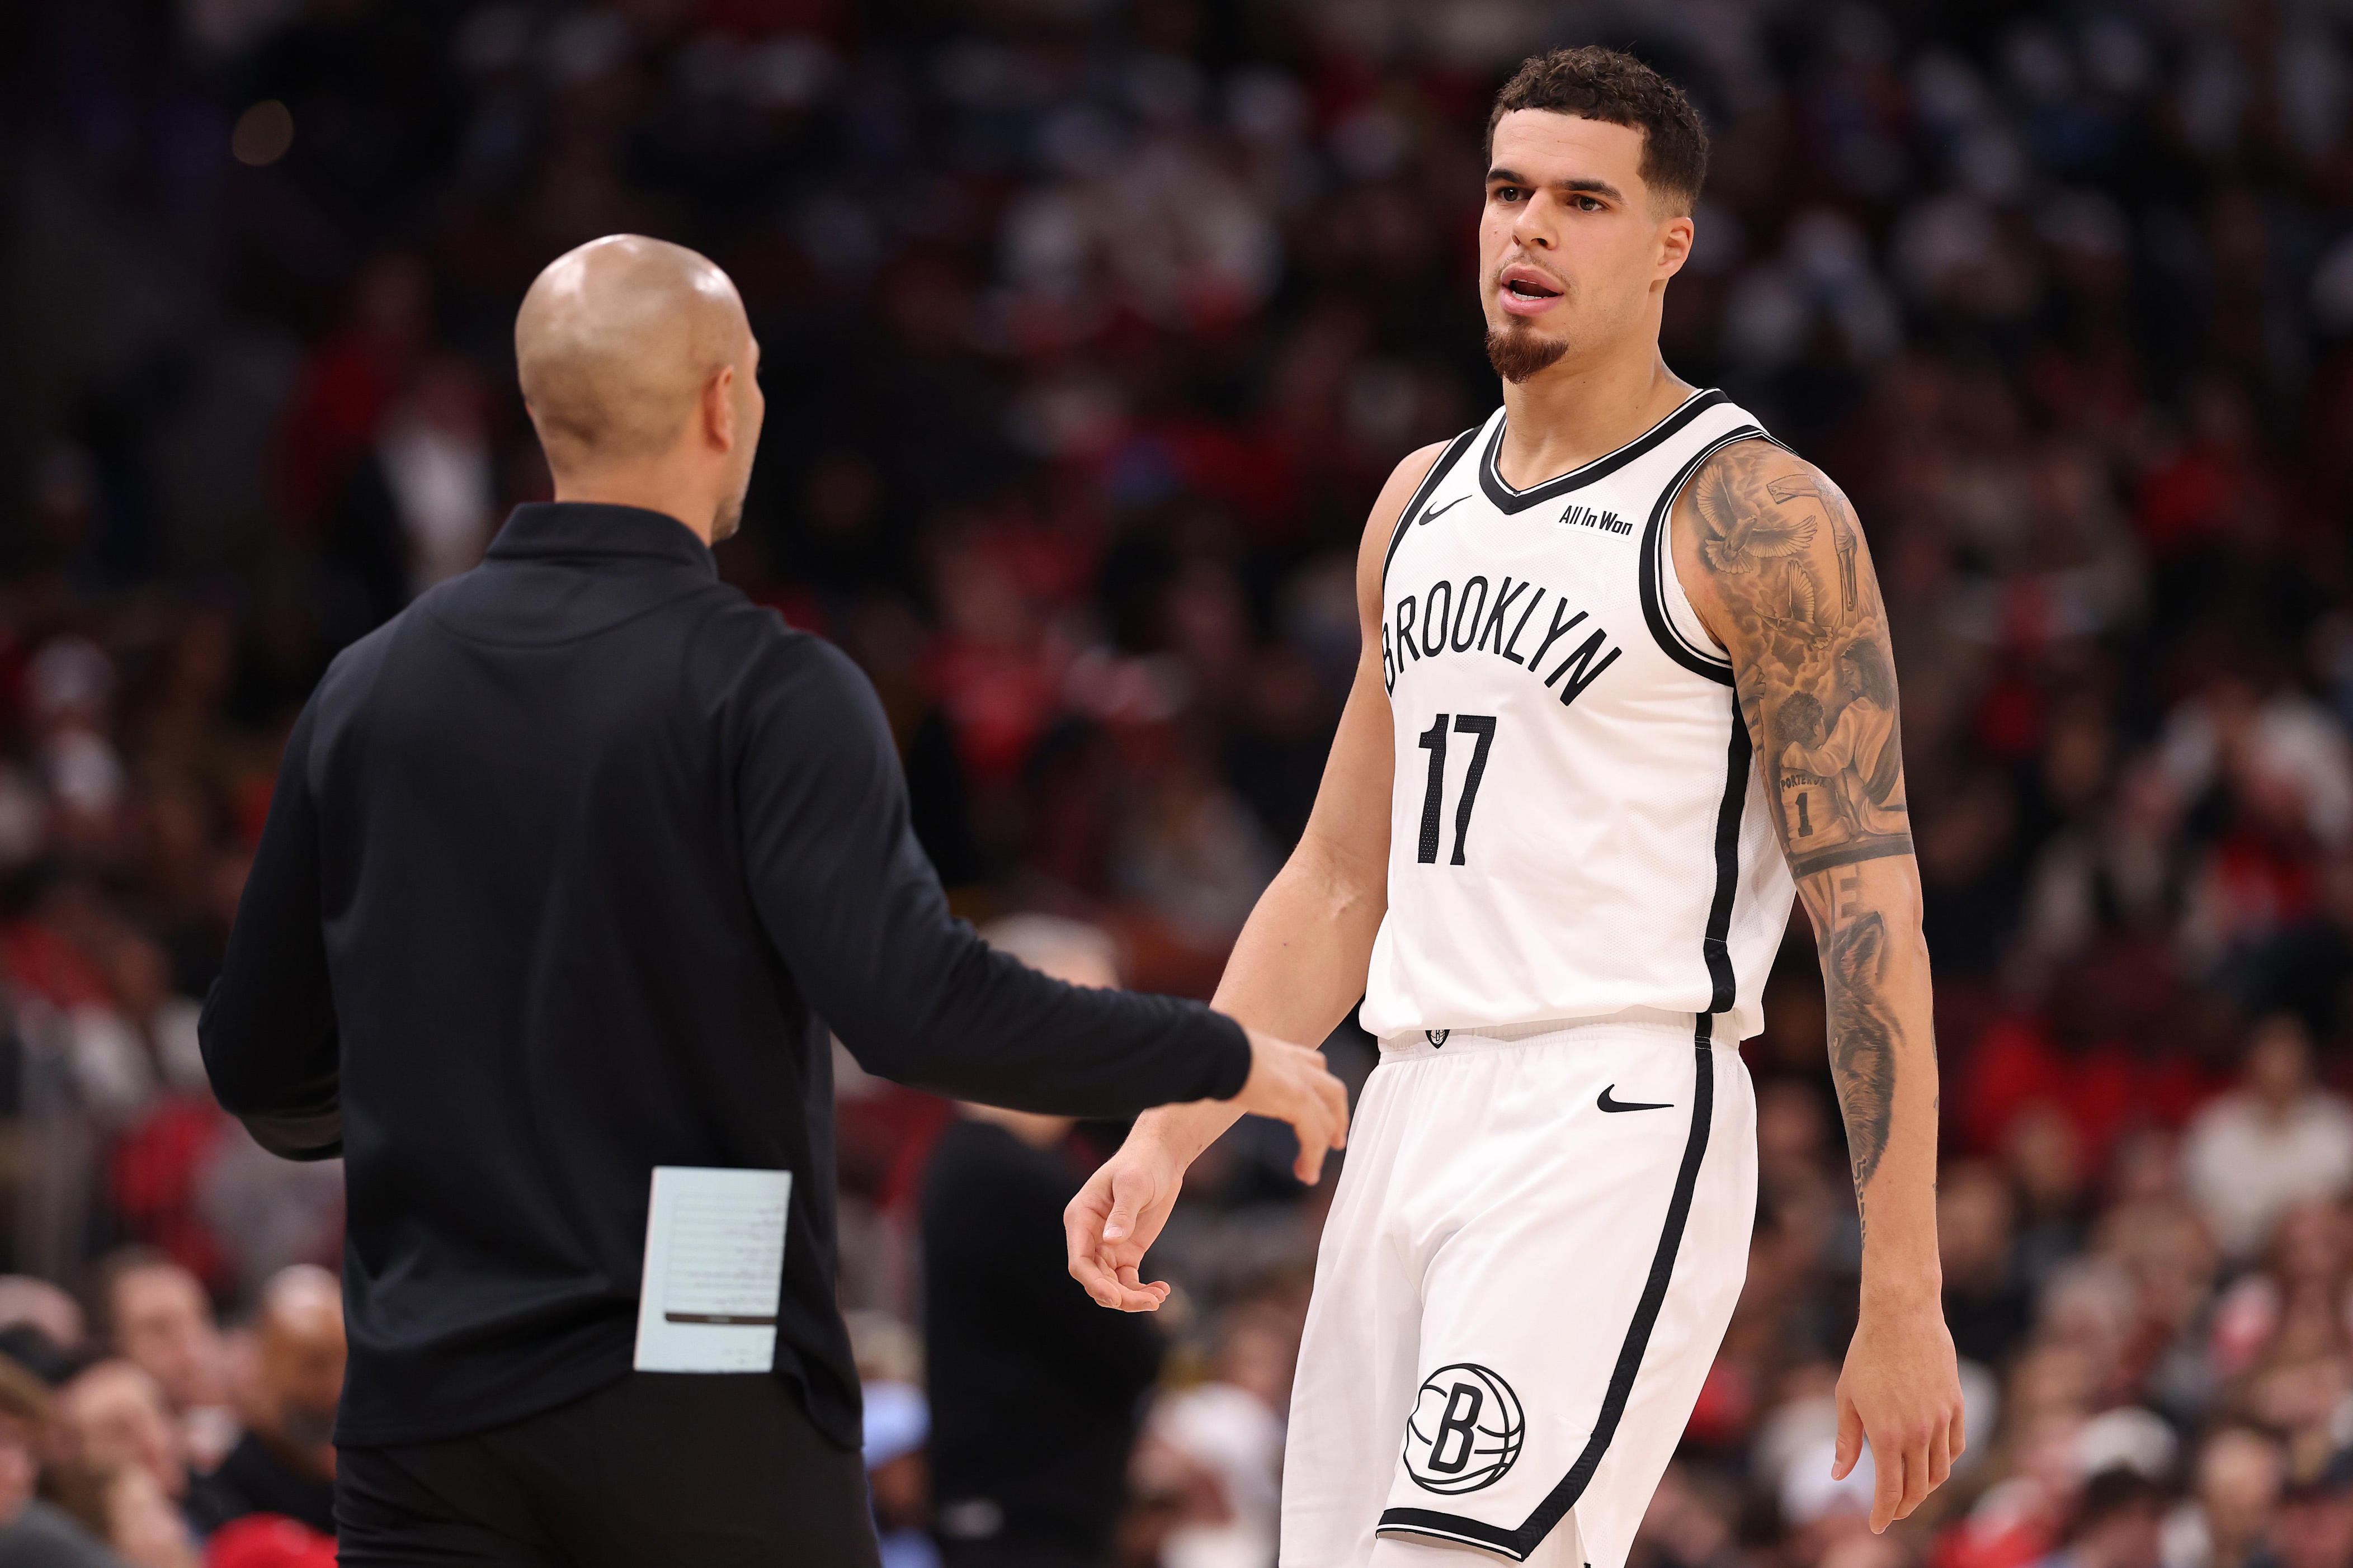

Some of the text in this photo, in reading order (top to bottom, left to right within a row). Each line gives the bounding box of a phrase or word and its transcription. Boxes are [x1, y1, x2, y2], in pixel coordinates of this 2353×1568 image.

[1559, 505, 1633, 536] All In Won
[1381, 575, 1623, 707] BROOKLYN
[1417, 714, 1497, 866] 17
[1780, 774, 1812, 792] PORTER
[1795, 792, 1813, 838] 1
[1427, 1382, 1483, 1474] B
